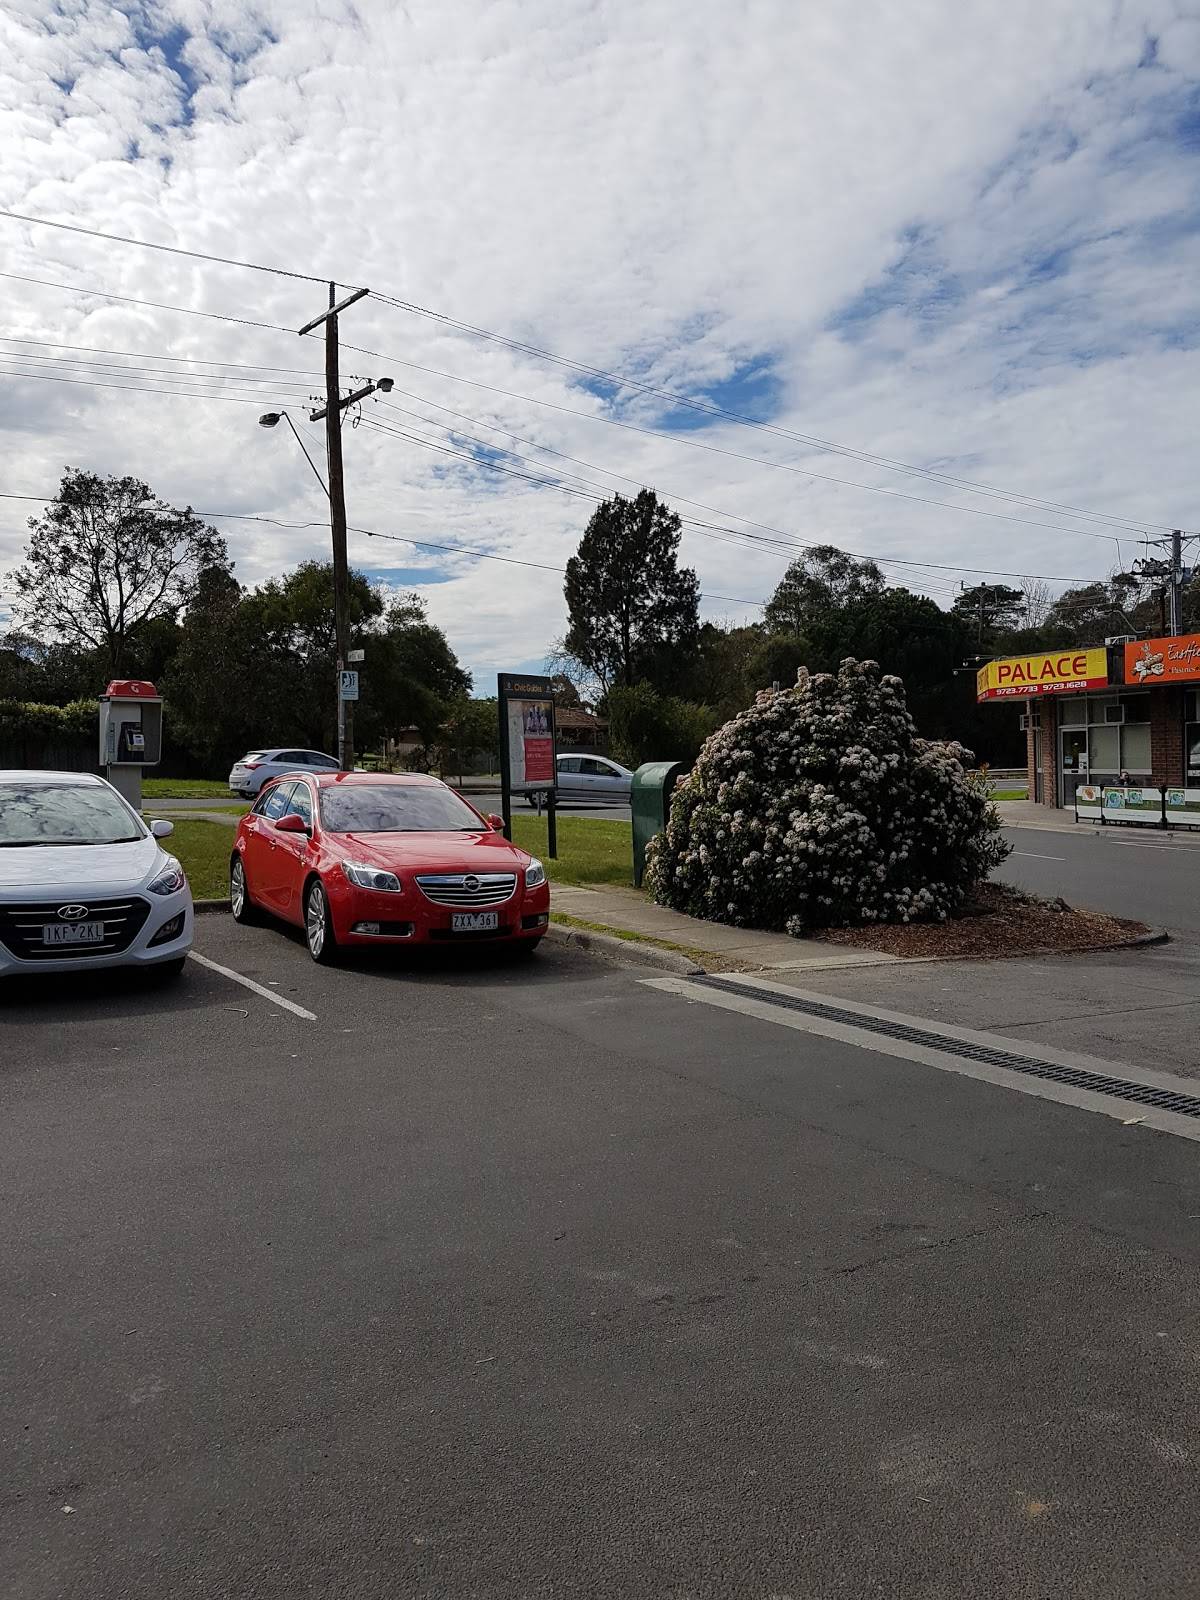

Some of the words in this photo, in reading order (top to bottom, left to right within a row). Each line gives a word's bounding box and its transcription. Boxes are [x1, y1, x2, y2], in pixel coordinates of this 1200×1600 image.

[998, 656, 1087, 684] PALACE
[996, 686, 1038, 696] 9723.7733
[1042, 681, 1088, 691] 9723.1628
[454, 915, 472, 927] ZXX
[480, 914, 496, 926] 361
